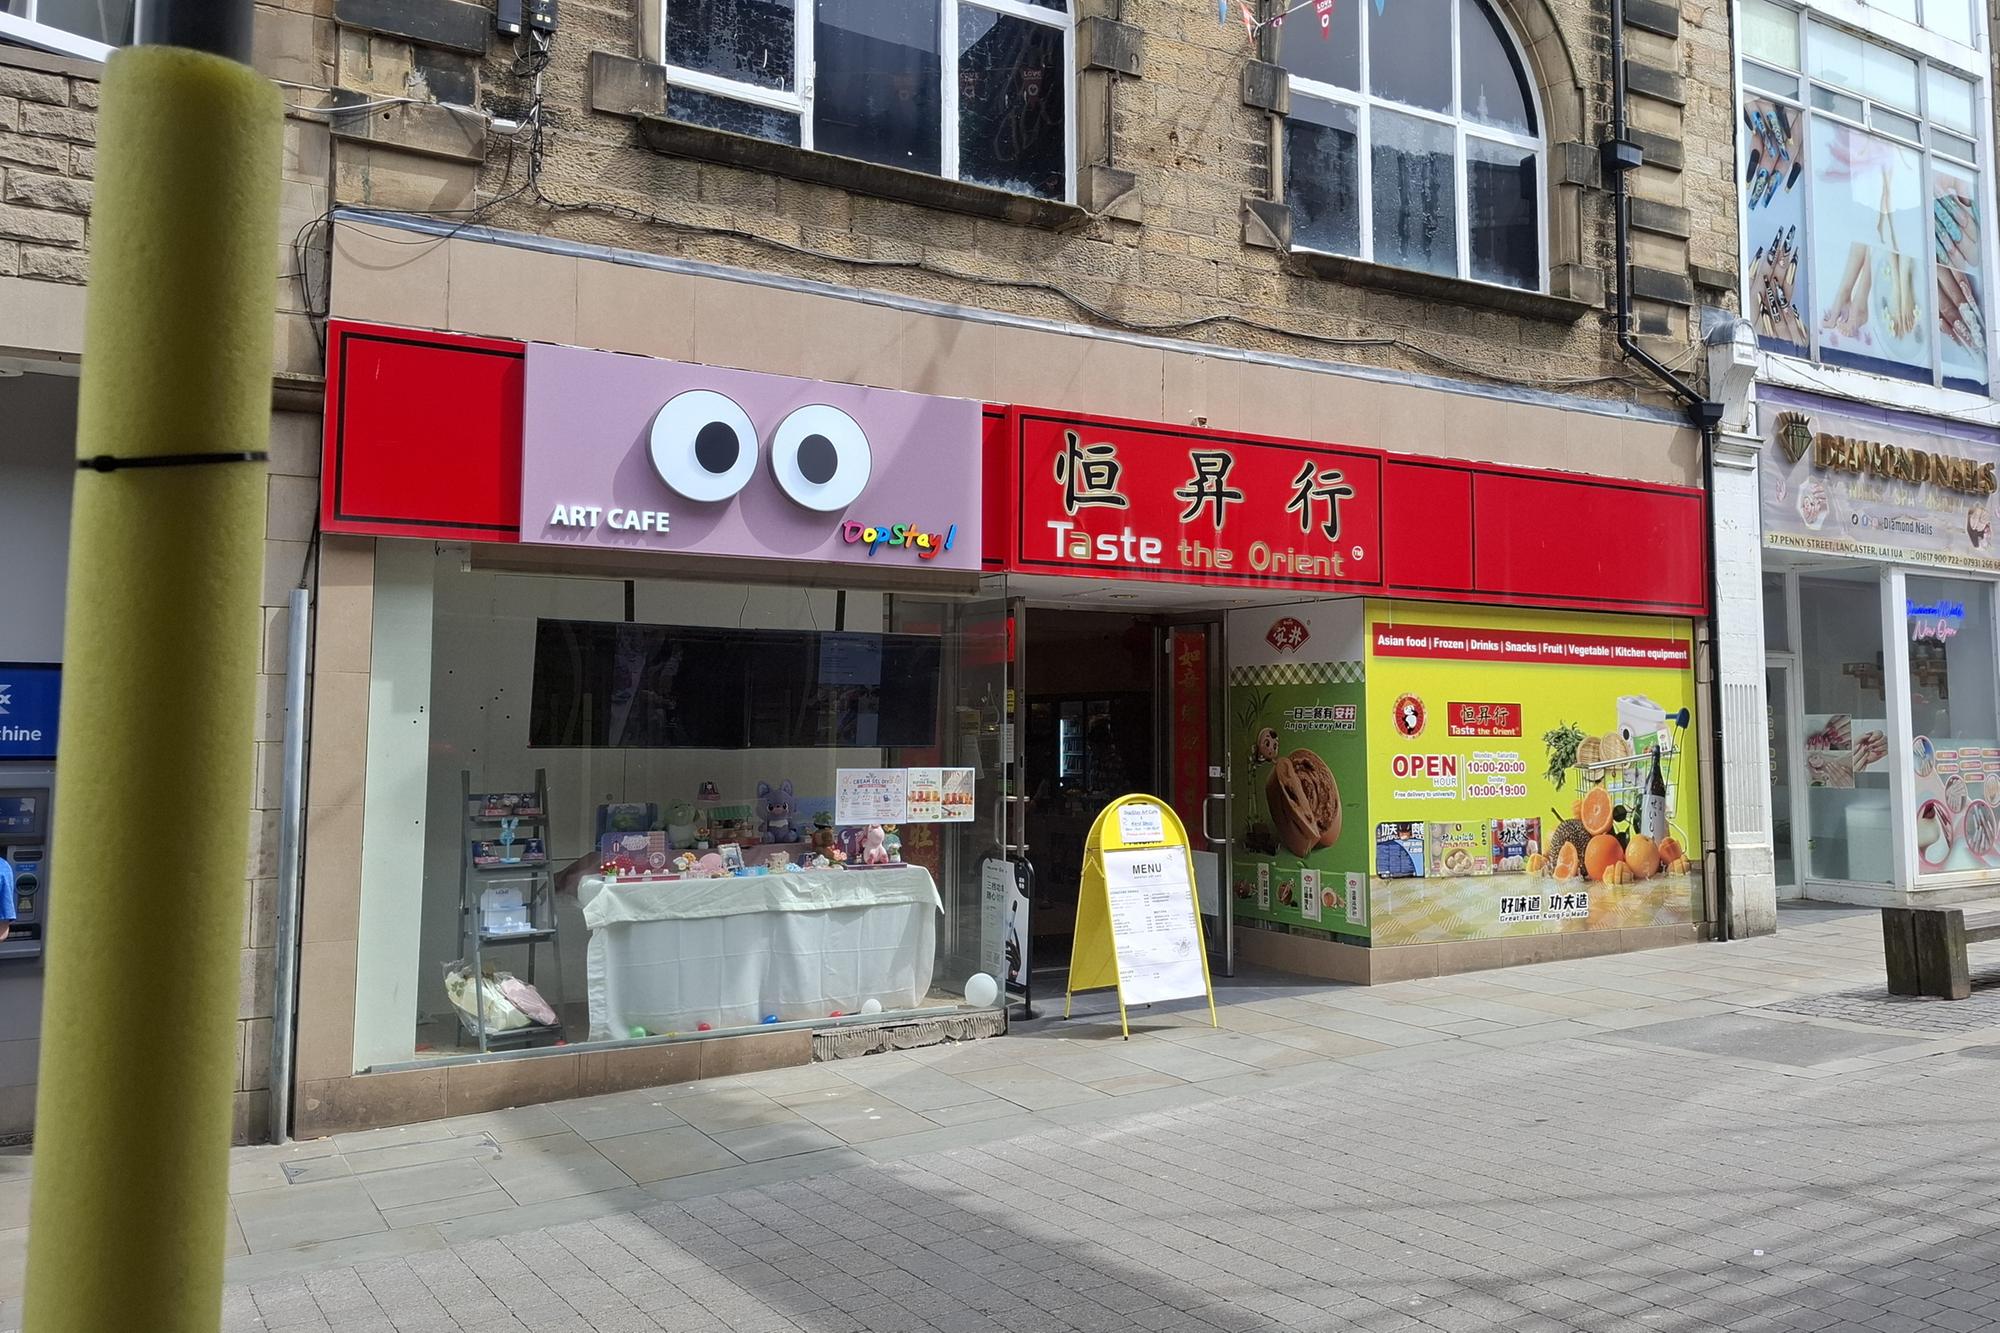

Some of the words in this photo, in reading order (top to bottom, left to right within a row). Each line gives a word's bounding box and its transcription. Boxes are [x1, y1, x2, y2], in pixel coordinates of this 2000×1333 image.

[1054, 429, 1354, 541] 恒昇行
[550, 503, 603, 528] ART
[607, 508, 670, 533] CAFE
[1883, 517, 1914, 533] Diamond
[1915, 522, 1933, 536] Nails
[1047, 520, 1162, 564] Taste
[1178, 539, 1234, 570] the
[1249, 540, 1344, 577] Orient
[1769, 534, 1778, 543] 37
[1780, 535, 1806, 548] PENNY
[1806, 538, 1834, 551] STREET,
[1836, 542, 1877, 556] LANCASTER,
[1378, 634, 1404, 646] Asian
[1406, 636, 1427, 647] food
[1433, 638, 1464, 649] Frozen
[1470, 639, 1499, 651] Drinks
[1505, 641, 1537, 653] Snacks
[1543, 643, 1563, 654] Fruit
[1568, 645, 1610, 657] Vegetable
[1615, 647, 1646, 657] Kitchen
[1647, 650, 1687, 660] equipment
[0, 725, 42, 741] hine
[1309, 721, 1333, 731] Every
[1335, 722, 1355, 730] Meal
[1451, 725, 1475, 735] Taste
[1478, 726, 1489, 735] the
[1493, 727, 1516, 735] Orient
[1393, 755, 1456, 777] OPEN
[1467, 762, 1525, 772] 10:00-20:00
[1433, 777, 1457, 786] HOUR
[1468, 785, 1526, 796] 10:00-19:00
[1132, 863, 1162, 874] MENU
[1501, 896, 1540, 914] 好味道
[1549, 893, 1588, 911] 功夫造
